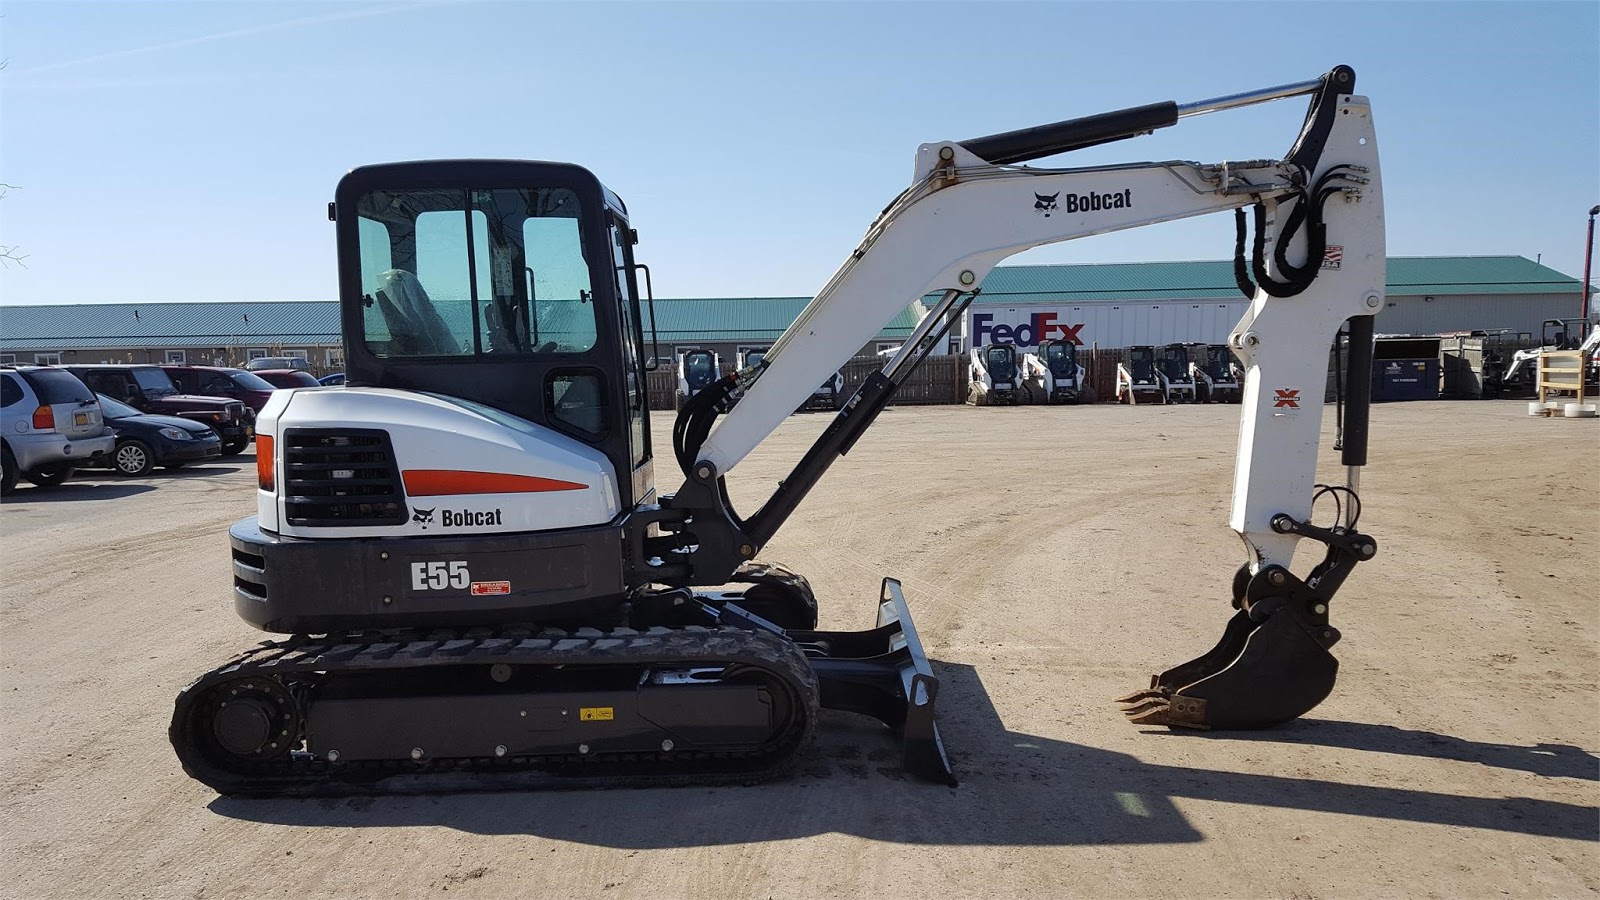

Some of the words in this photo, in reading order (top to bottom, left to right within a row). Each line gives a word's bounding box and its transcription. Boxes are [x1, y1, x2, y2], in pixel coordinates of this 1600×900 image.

[1066, 188, 1132, 213] Bobcat
[972, 312, 1086, 348] FedEx
[441, 508, 502, 527] Bobcat
[410, 560, 471, 591] E55
